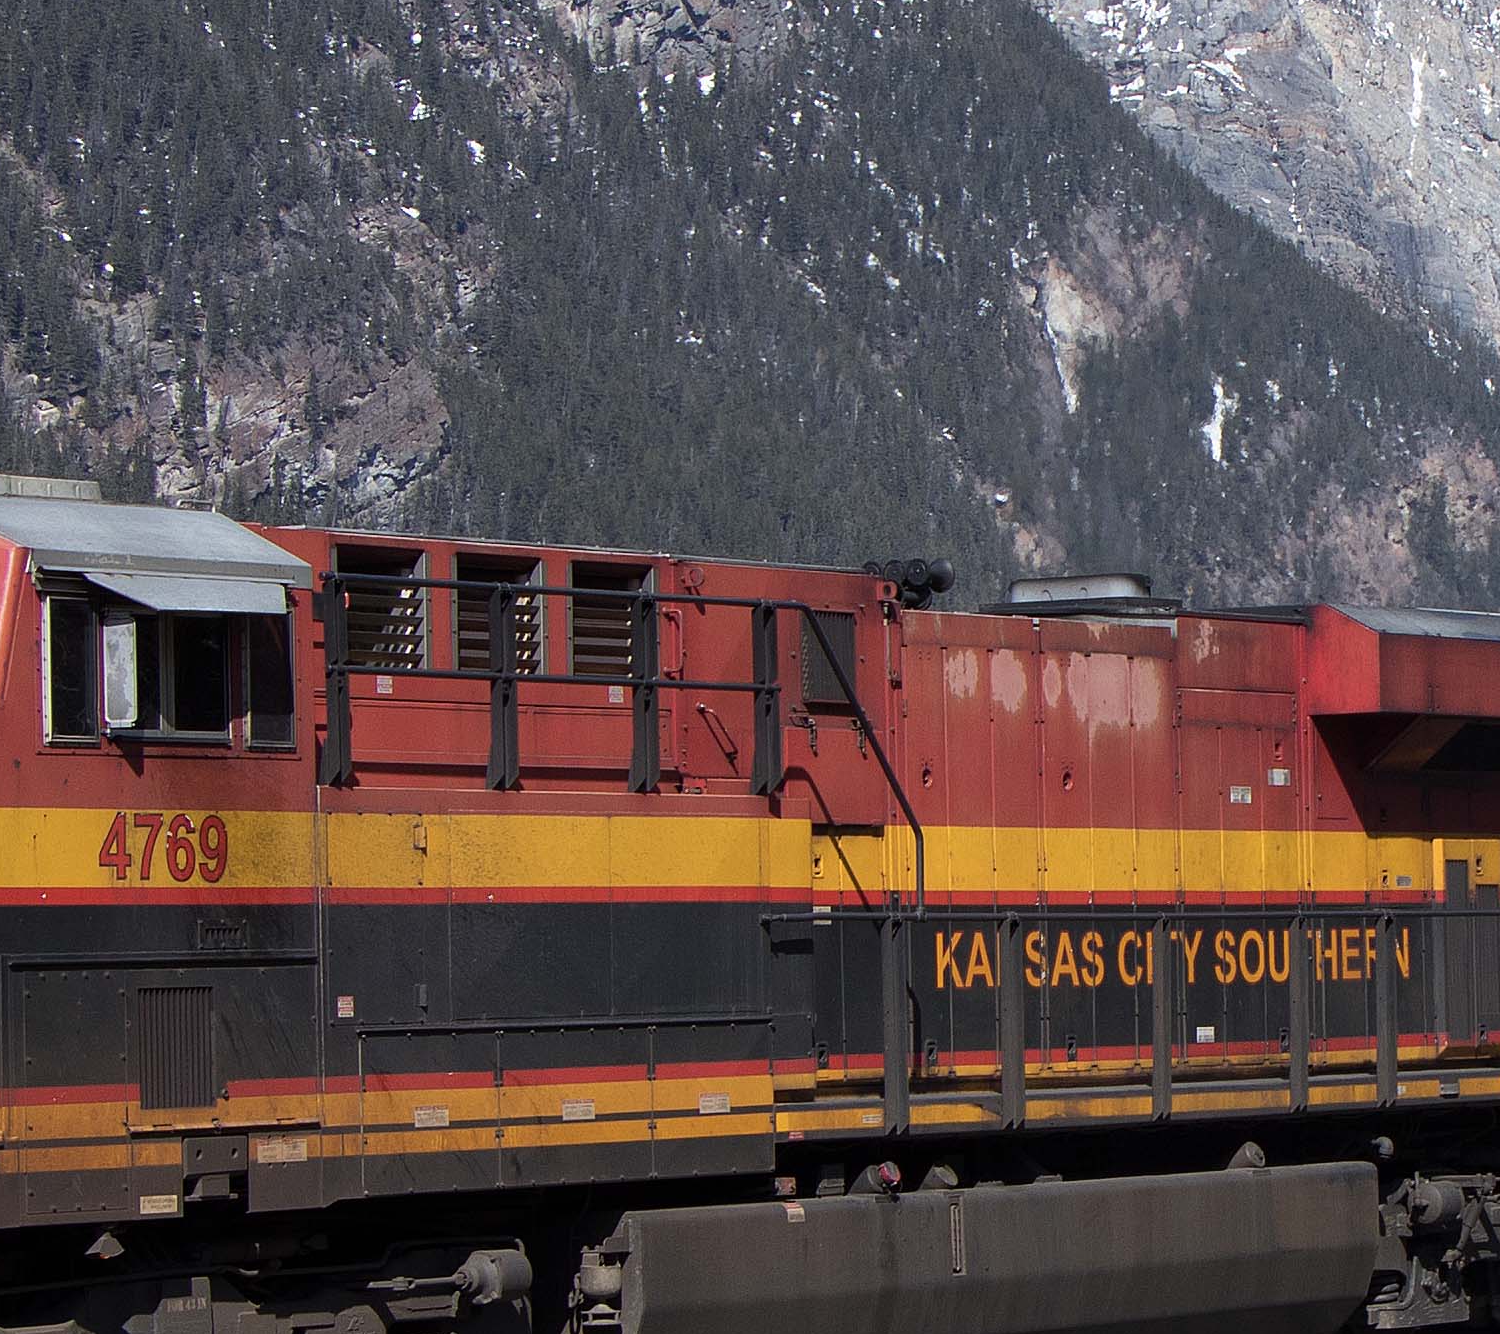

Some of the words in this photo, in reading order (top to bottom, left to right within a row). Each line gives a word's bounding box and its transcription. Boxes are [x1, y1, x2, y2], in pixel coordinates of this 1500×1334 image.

[98, 811, 228, 884] 4769
[935, 930, 1105, 988] KASAS
[1118, 928, 1203, 986] CIY
[1214, 928, 1411, 984] SOUHEN
